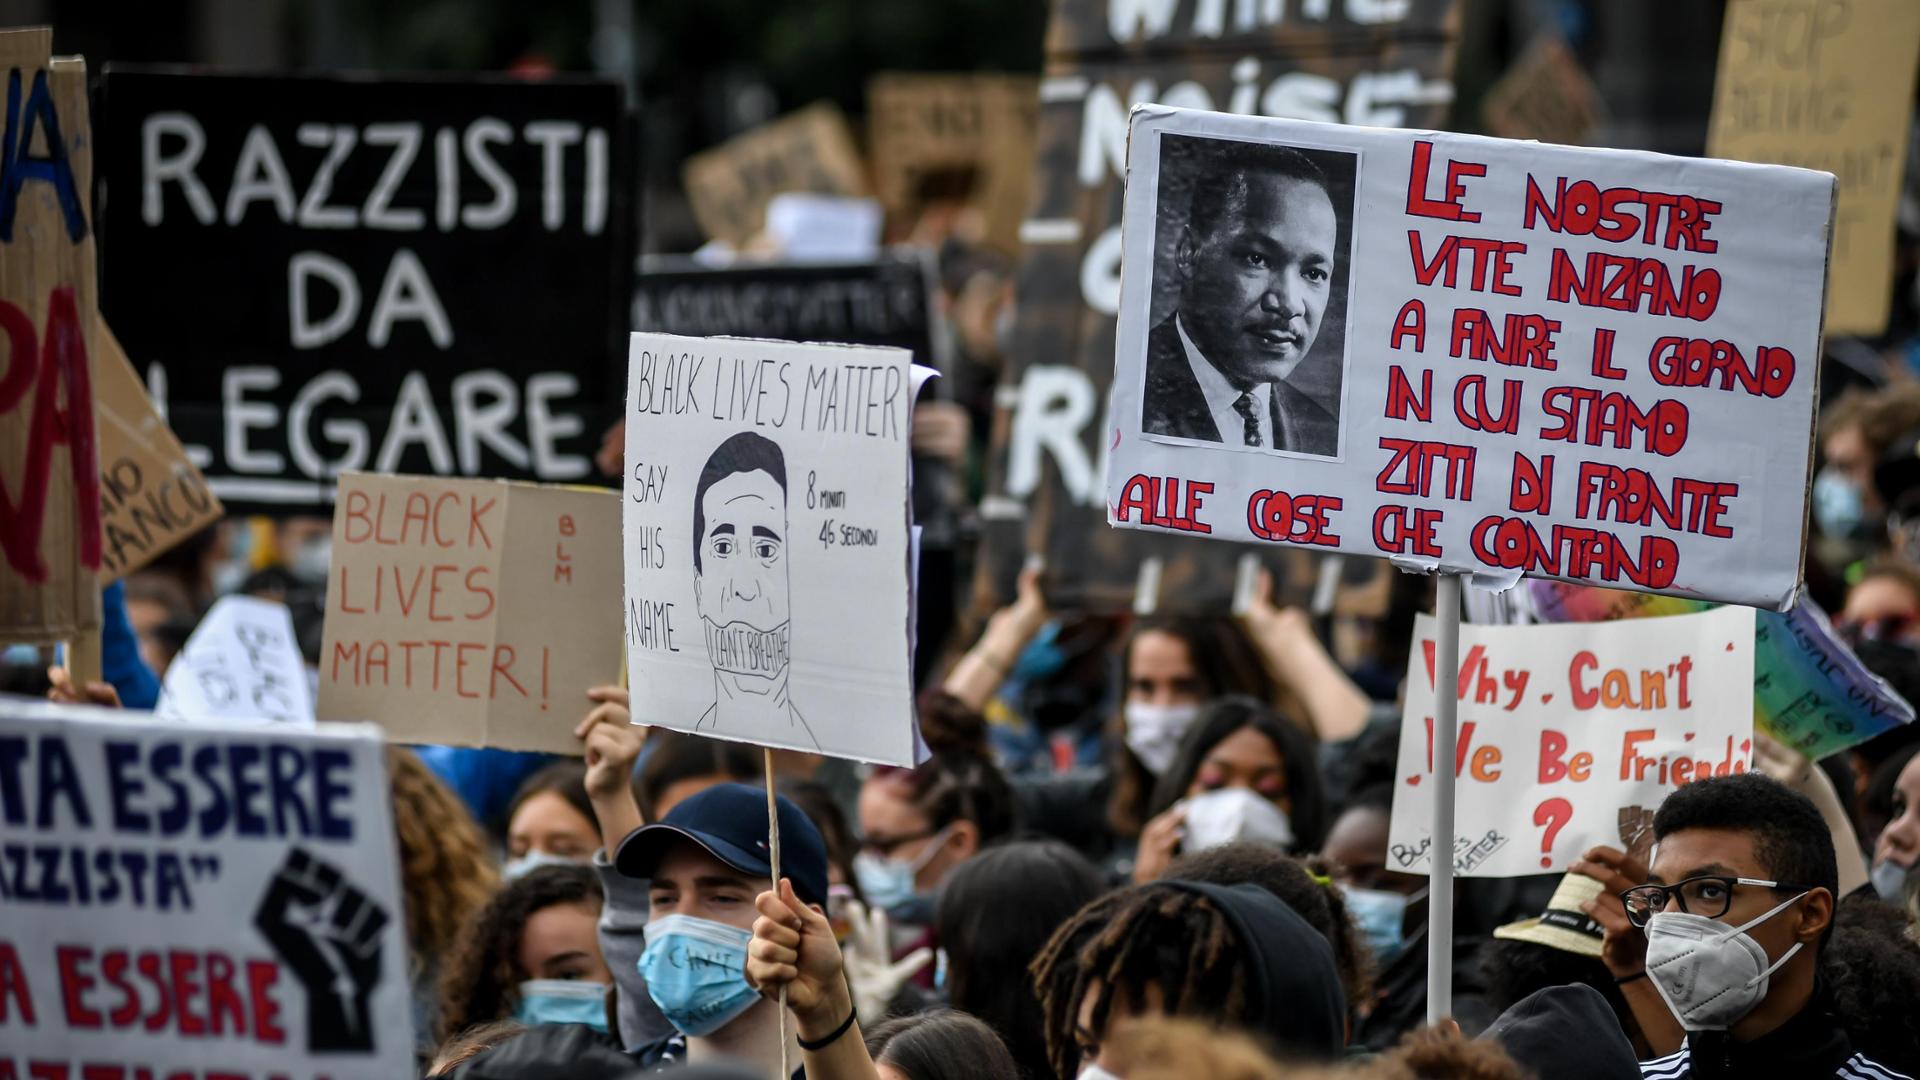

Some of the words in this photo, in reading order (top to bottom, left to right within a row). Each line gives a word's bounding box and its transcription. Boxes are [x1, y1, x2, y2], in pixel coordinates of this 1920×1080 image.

[142, 112, 609, 234] RAZZISTI
[1405, 140, 1487, 224] LE
[1523, 172, 1722, 254] NOSTRE
[1408, 230, 1527, 297] VITE
[288, 250, 453, 349] DA
[1391, 299, 1426, 353] A
[1449, 308, 1562, 371] FINIRE
[1591, 328, 1627, 380] IL
[1649, 336, 1795, 398] GIORNO
[637, 351, 704, 415] BLACK
[713, 357, 790, 428] LIVES
[801, 364, 900, 440] MATTER
[1385, 365, 1433, 423] IN
[1454, 374, 1523, 435] CUI
[1539, 385, 1689, 457] STIAMO
[632, 463, 668, 503] SAY
[807, 470, 816, 510] 8
[1376, 437, 1477, 501] ZITTI
[1510, 451, 1554, 515] DI
[1576, 461, 1738, 538] FRONTE
[345, 490, 495, 550] BLACK
[640, 526, 665, 569] HIS
[819, 518, 835, 550] 46
[840, 523, 878, 547] SECONDI
[1117, 473, 1214, 534] ALLE
[1247, 489, 1343, 547] COSE
[1372, 505, 1443, 558] CHE
[1470, 515, 1679, 589] CONTANO
[341, 565, 496, 622] LIVES
[631, 597, 680, 652] NAME
[333, 640, 549, 711] MATTER!
[708, 624, 714, 658] I
[715, 627, 745, 670] CAN'T
[747, 626, 790, 672] BREATHE
[1568, 650, 1693, 711] Can't
[104, 741, 355, 842] ESSERE
[1538, 730, 1593, 785] Be
[1533, 797, 1573, 869] ?
[56, 944, 287, 1046] ESSERE
